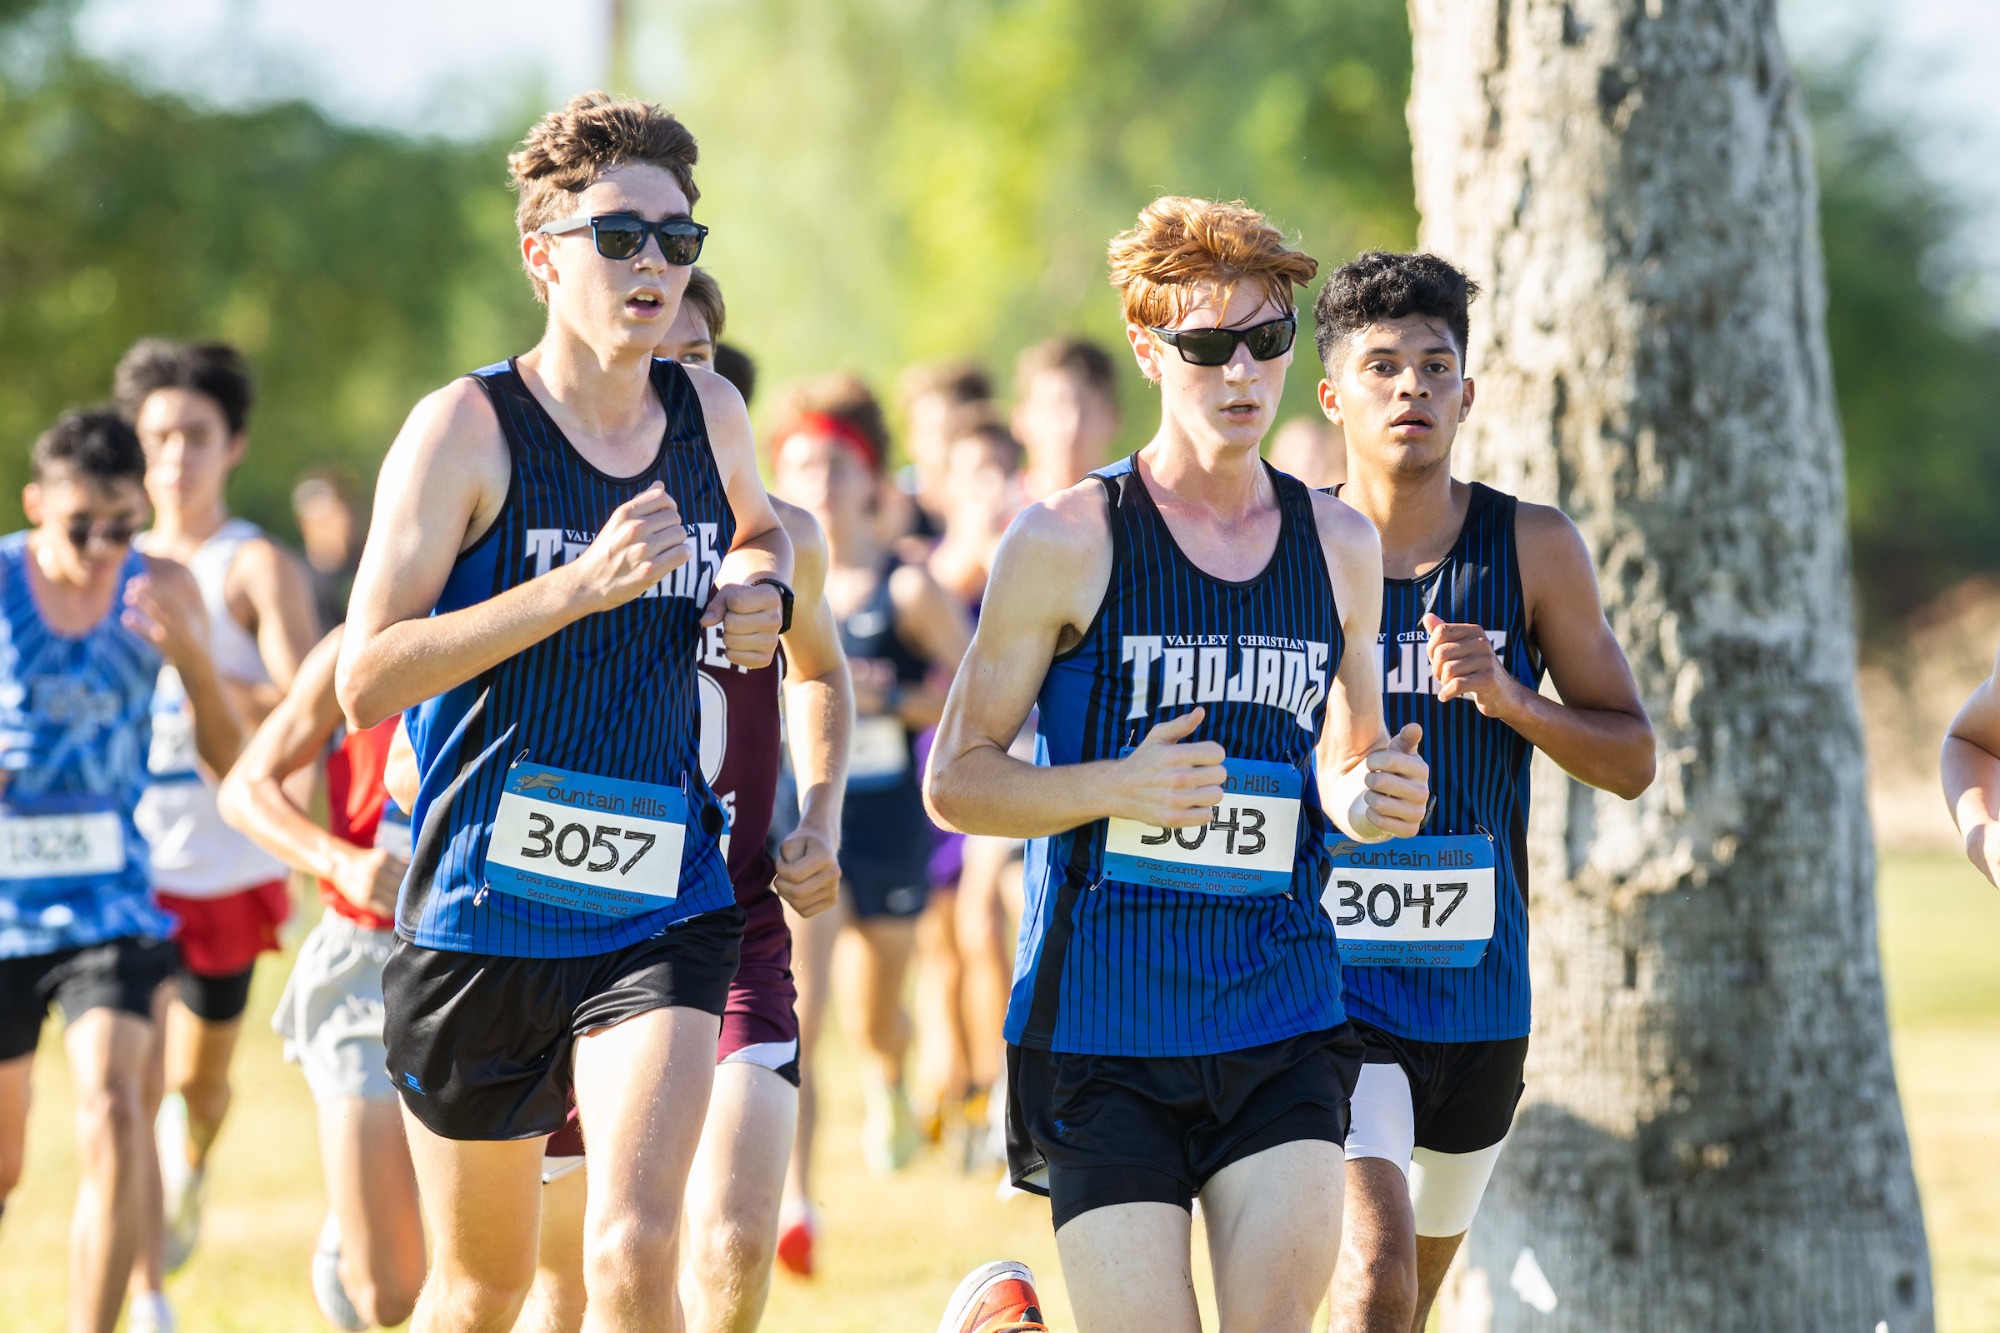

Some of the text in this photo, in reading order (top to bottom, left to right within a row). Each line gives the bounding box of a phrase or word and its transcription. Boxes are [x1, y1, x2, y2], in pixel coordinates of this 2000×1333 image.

[565, 530, 596, 542] VAL
[1165, 634, 1305, 650] VALLEY CHRISTIAN
[1121, 635, 1329, 733] TROJANS
[1243, 774, 1280, 794] Hills
[631, 796, 668, 818] Hills
[520, 812, 656, 876] 3057
[1437, 849, 1474, 867] Hills
[1136, 860, 1262, 882] Cross Country Invitational
[516, 872, 644, 904] Cross Country Invitational
[1149, 875, 1201, 890] September
[1228, 884, 1248, 894] 2022
[527, 888, 579, 907] September
[607, 905, 628, 916] 2022
[1336, 880, 1468, 928] 3047
[1337, 942, 1465, 953] Cross Country Invitational
[1350, 955, 1401, 965] September
[1428, 956, 1451, 965] 2022
